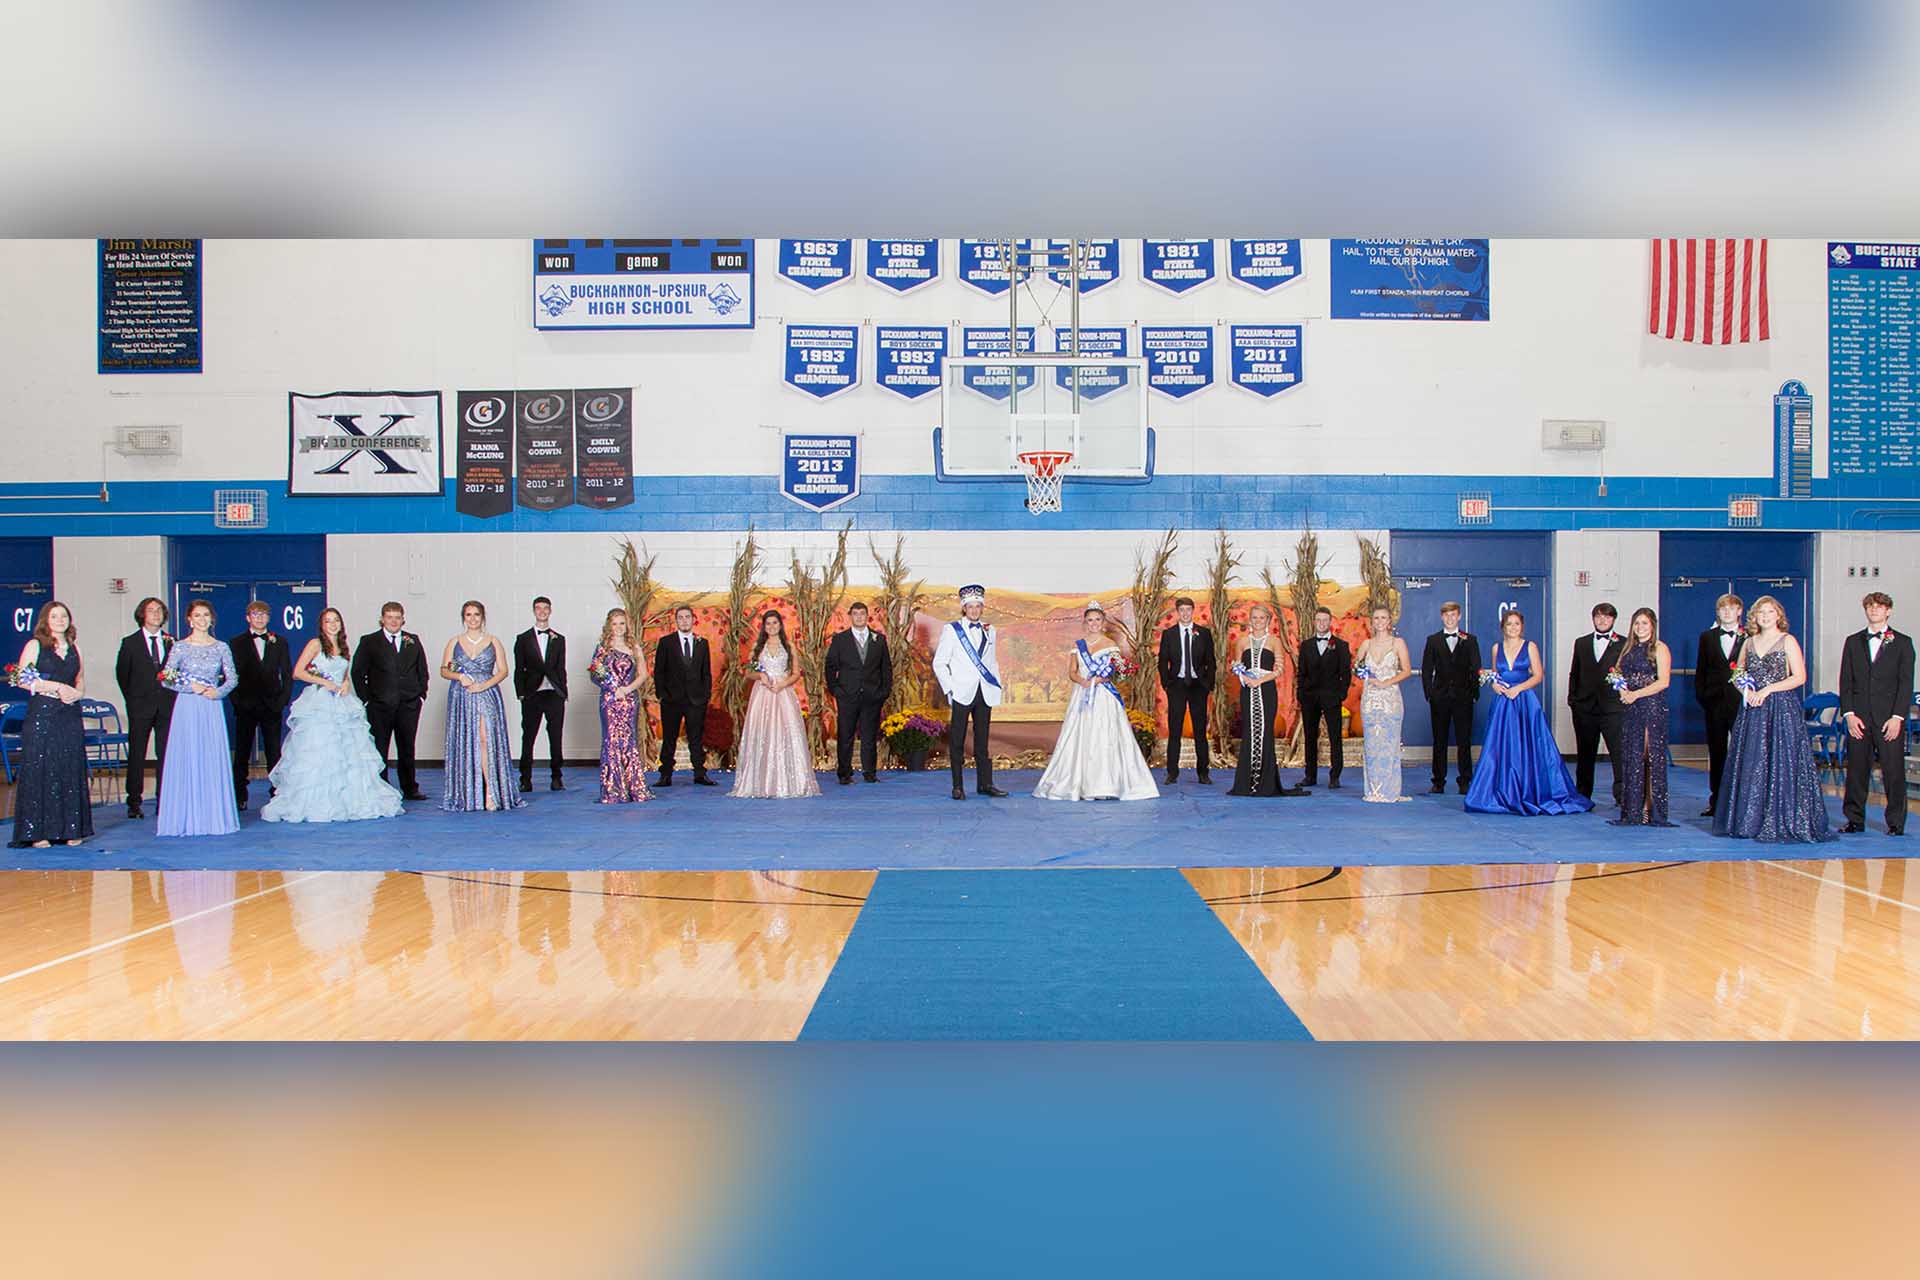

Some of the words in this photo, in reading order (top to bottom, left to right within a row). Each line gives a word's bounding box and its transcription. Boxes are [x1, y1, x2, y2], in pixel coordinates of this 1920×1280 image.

[794, 242, 839, 255] 1963
[880, 244, 926, 256] 1966
[1156, 245, 1200, 258] 1981
[1244, 242, 1288, 256] 1982
[1365, 248, 1376, 256] TO
[1404, 248, 1422, 256] OUR
[1422, 248, 1446, 256] ALMA
[1856, 245, 1920, 256] BUCCANEE
[140, 252, 159, 260] Years
[160, 252, 170, 260] Of
[171, 252, 196, 260] Service
[717, 255, 742, 267] won
[800, 256, 831, 266] STATE
[1392, 256, 1410, 266] OUR
[1412, 257, 1426, 266] B-U
[171, 260, 192, 268] Coach
[544, 257, 569, 268] won
[626, 256, 658, 270] game
[888, 258, 918, 268] STATE
[1164, 260, 1194, 269] STATE
[1252, 257, 1282, 266] STATE
[1880, 258, 1917, 268] STATE
[788, 266, 843, 277] CHAMPIONS
[876, 268, 930, 278] CHAMPIONS
[968, 271, 1023, 280] CHAMPIOS
[1152, 269, 1206, 279] CHAMPIONS
[1240, 266, 1294, 277] CHAMPIONS
[570, 284, 707, 298] BUCKHANNON-UPSHUR
[588, 301, 625, 315] HIGH
[632, 300, 693, 314] SCHOOL
[801, 350, 845, 362] 1993
[890, 350, 935, 364] 1993
[1154, 350, 1200, 363] 2010
[1244, 348, 1288, 362] 2011
[807, 364, 838, 374] STATE
[897, 366, 928, 375] STATE
[985, 366, 1013, 376] STAT
[1077, 366, 1108, 376] TATE
[1163, 366, 1194, 375] STATE
[1252, 364, 1282, 373] STATE
[794, 374, 850, 384] CHAMPIONS
[885, 376, 940, 384] CHAMPIONS
[1152, 376, 1206, 384] CHAMPIONS
[1240, 373, 1294, 382] CHAMPIONS
[474, 400, 492, 422] G
[310, 438, 329, 448] BIG
[334, 438, 346, 448] 10
[351, 438, 421, 448] CONFERENCE
[532, 440, 557, 448] EMILY
[591, 438, 616, 446] EMILY
[528, 448, 562, 456] GODWIN
[586, 446, 620, 454] GODWIN
[798, 460, 844, 472] 2013
[526, 480, 548, 488] 2010
[557, 480, 565, 488] 11
[586, 478, 604, 487] 2011
[614, 478, 624, 486] 12
[806, 474, 836, 484] STATE
[465, 484, 485, 492] 2017
[495, 484, 504, 492] 18
[794, 484, 848, 494] CHAMPIONS
[232, 505, 249, 520] EXIT
[1465, 501, 1484, 516] EXIT
[1736, 502, 1753, 516] EXIT
[15, 608, 33, 632] C7
[284, 606, 303, 630] C6
